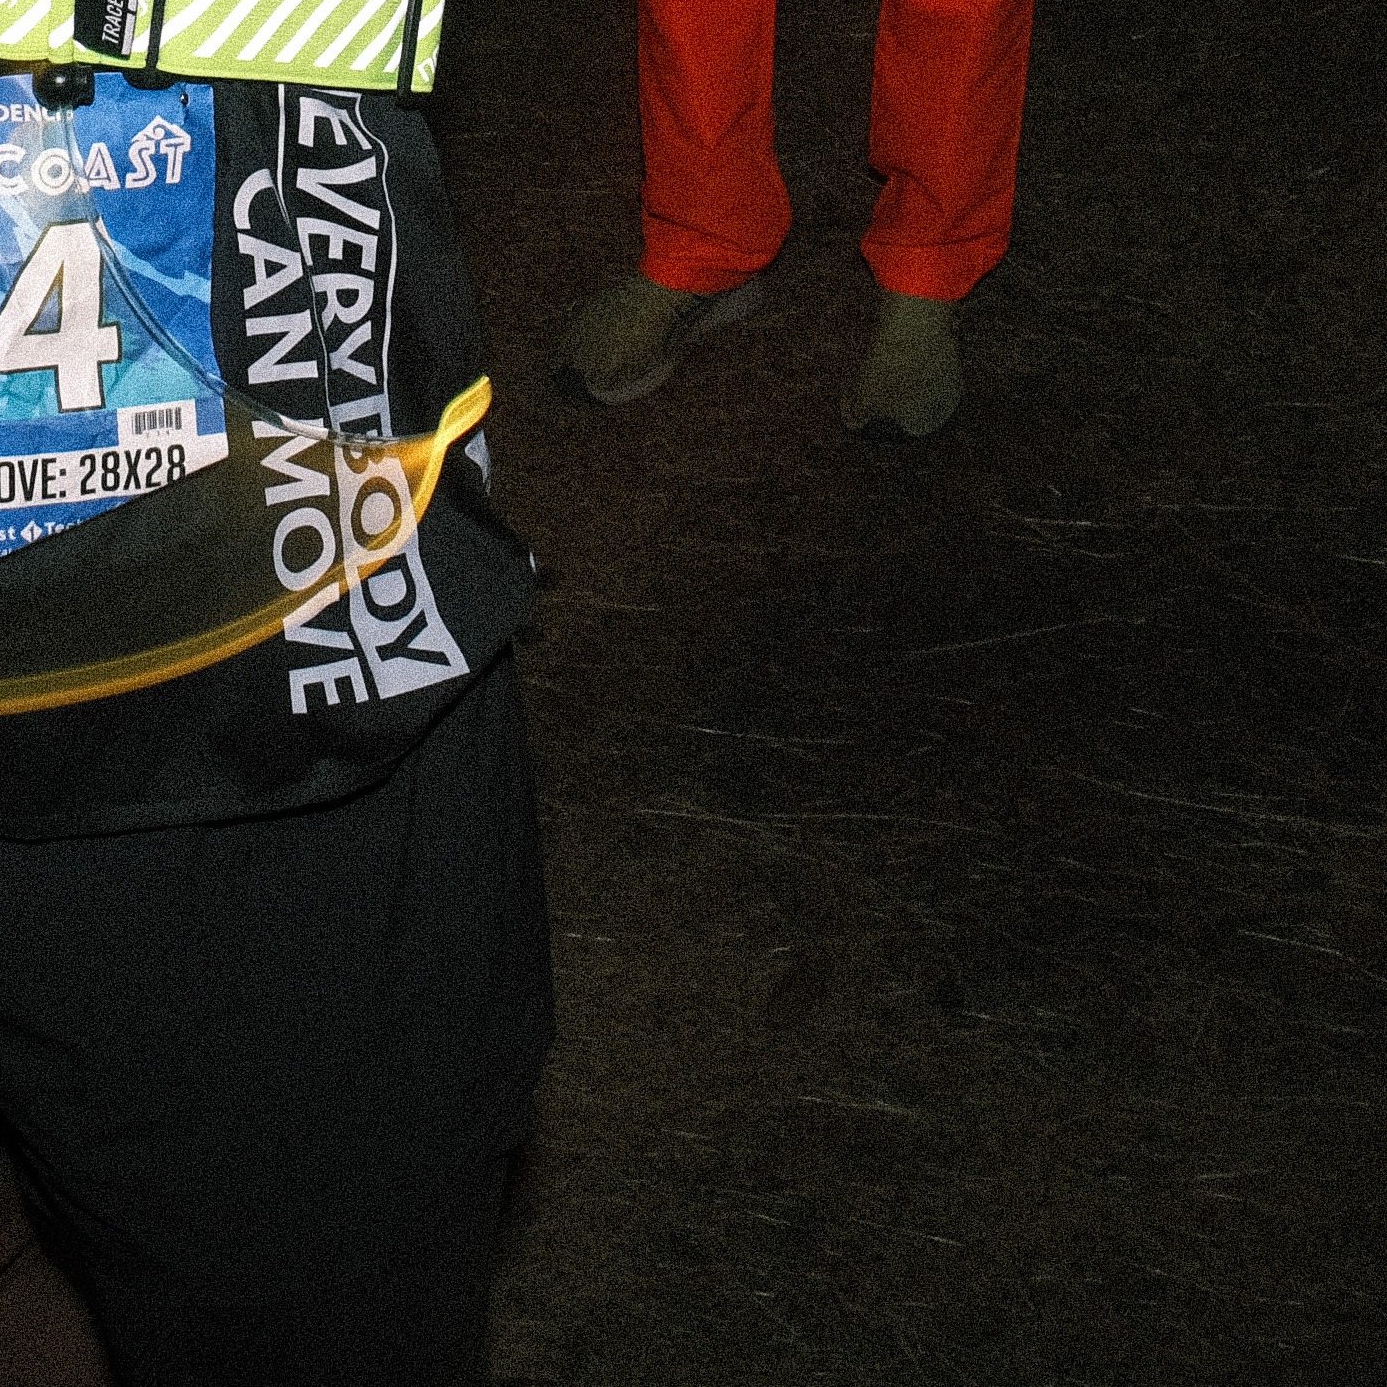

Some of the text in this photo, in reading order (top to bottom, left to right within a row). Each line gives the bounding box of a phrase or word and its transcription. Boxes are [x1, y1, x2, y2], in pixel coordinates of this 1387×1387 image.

[296, 95, 382, 387] EVERY
[79, 444, 187, 497] 28X28
[233, 167, 371, 715] CAN MOVE
